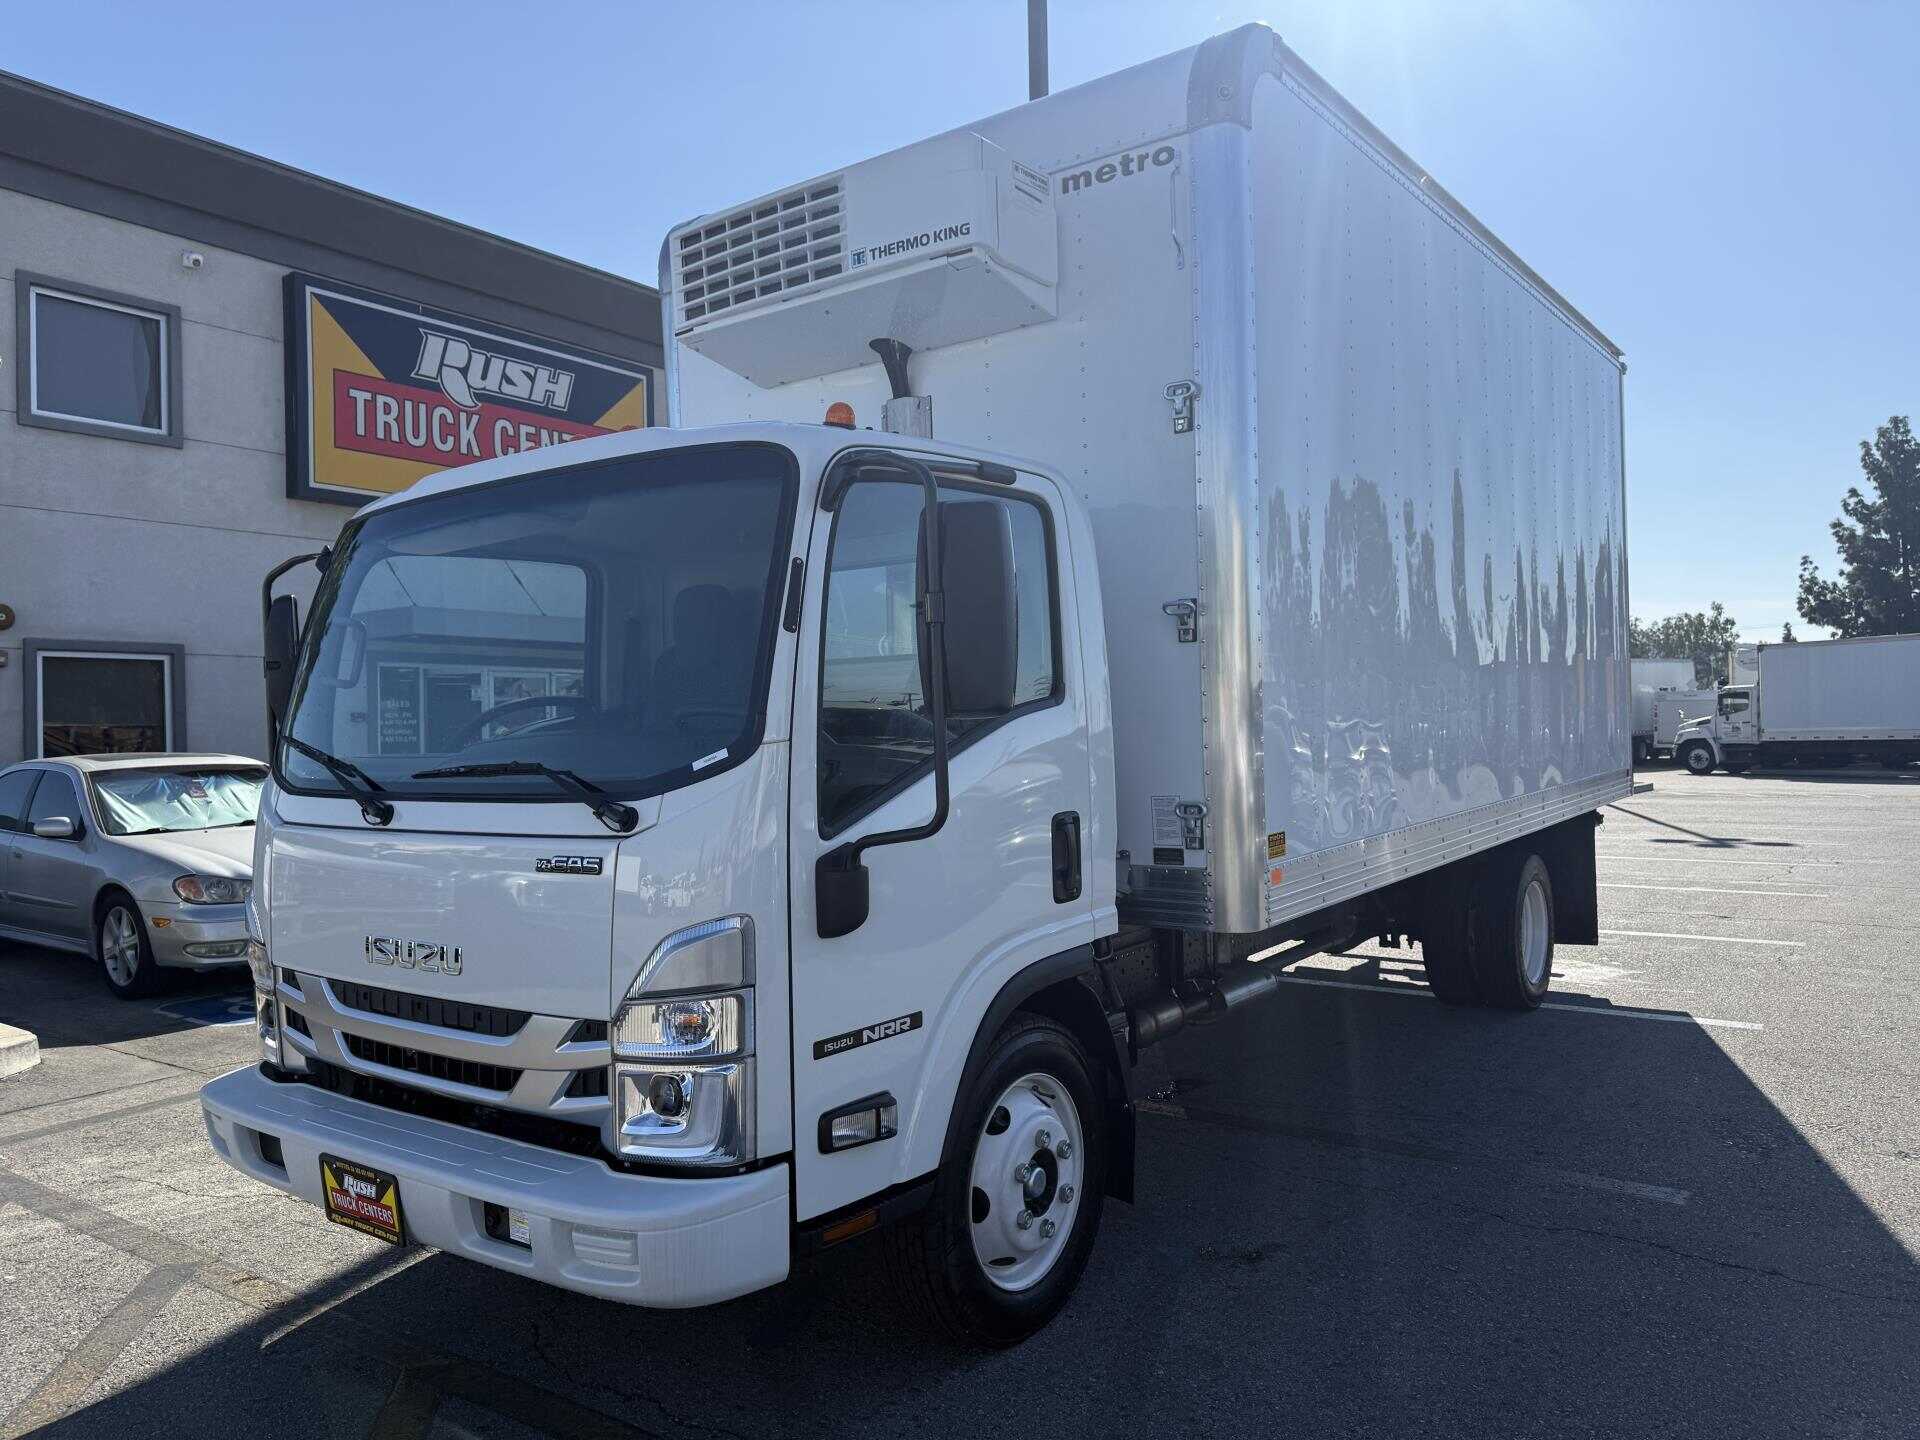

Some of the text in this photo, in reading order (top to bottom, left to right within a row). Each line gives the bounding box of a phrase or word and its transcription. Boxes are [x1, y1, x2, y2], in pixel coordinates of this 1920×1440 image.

[1062, 146, 1175, 194] metro
[869, 233, 931, 261] THERMO
[933, 222, 971, 243] KING
[348, 387, 576, 458] TRUCK CEN
[364, 934, 463, 976] ISUZU
[824, 1017, 911, 1053] ISUZU NRR
[332, 1191, 358, 1211] TRUCK
[358, 1200, 394, 1224] CENTERS
